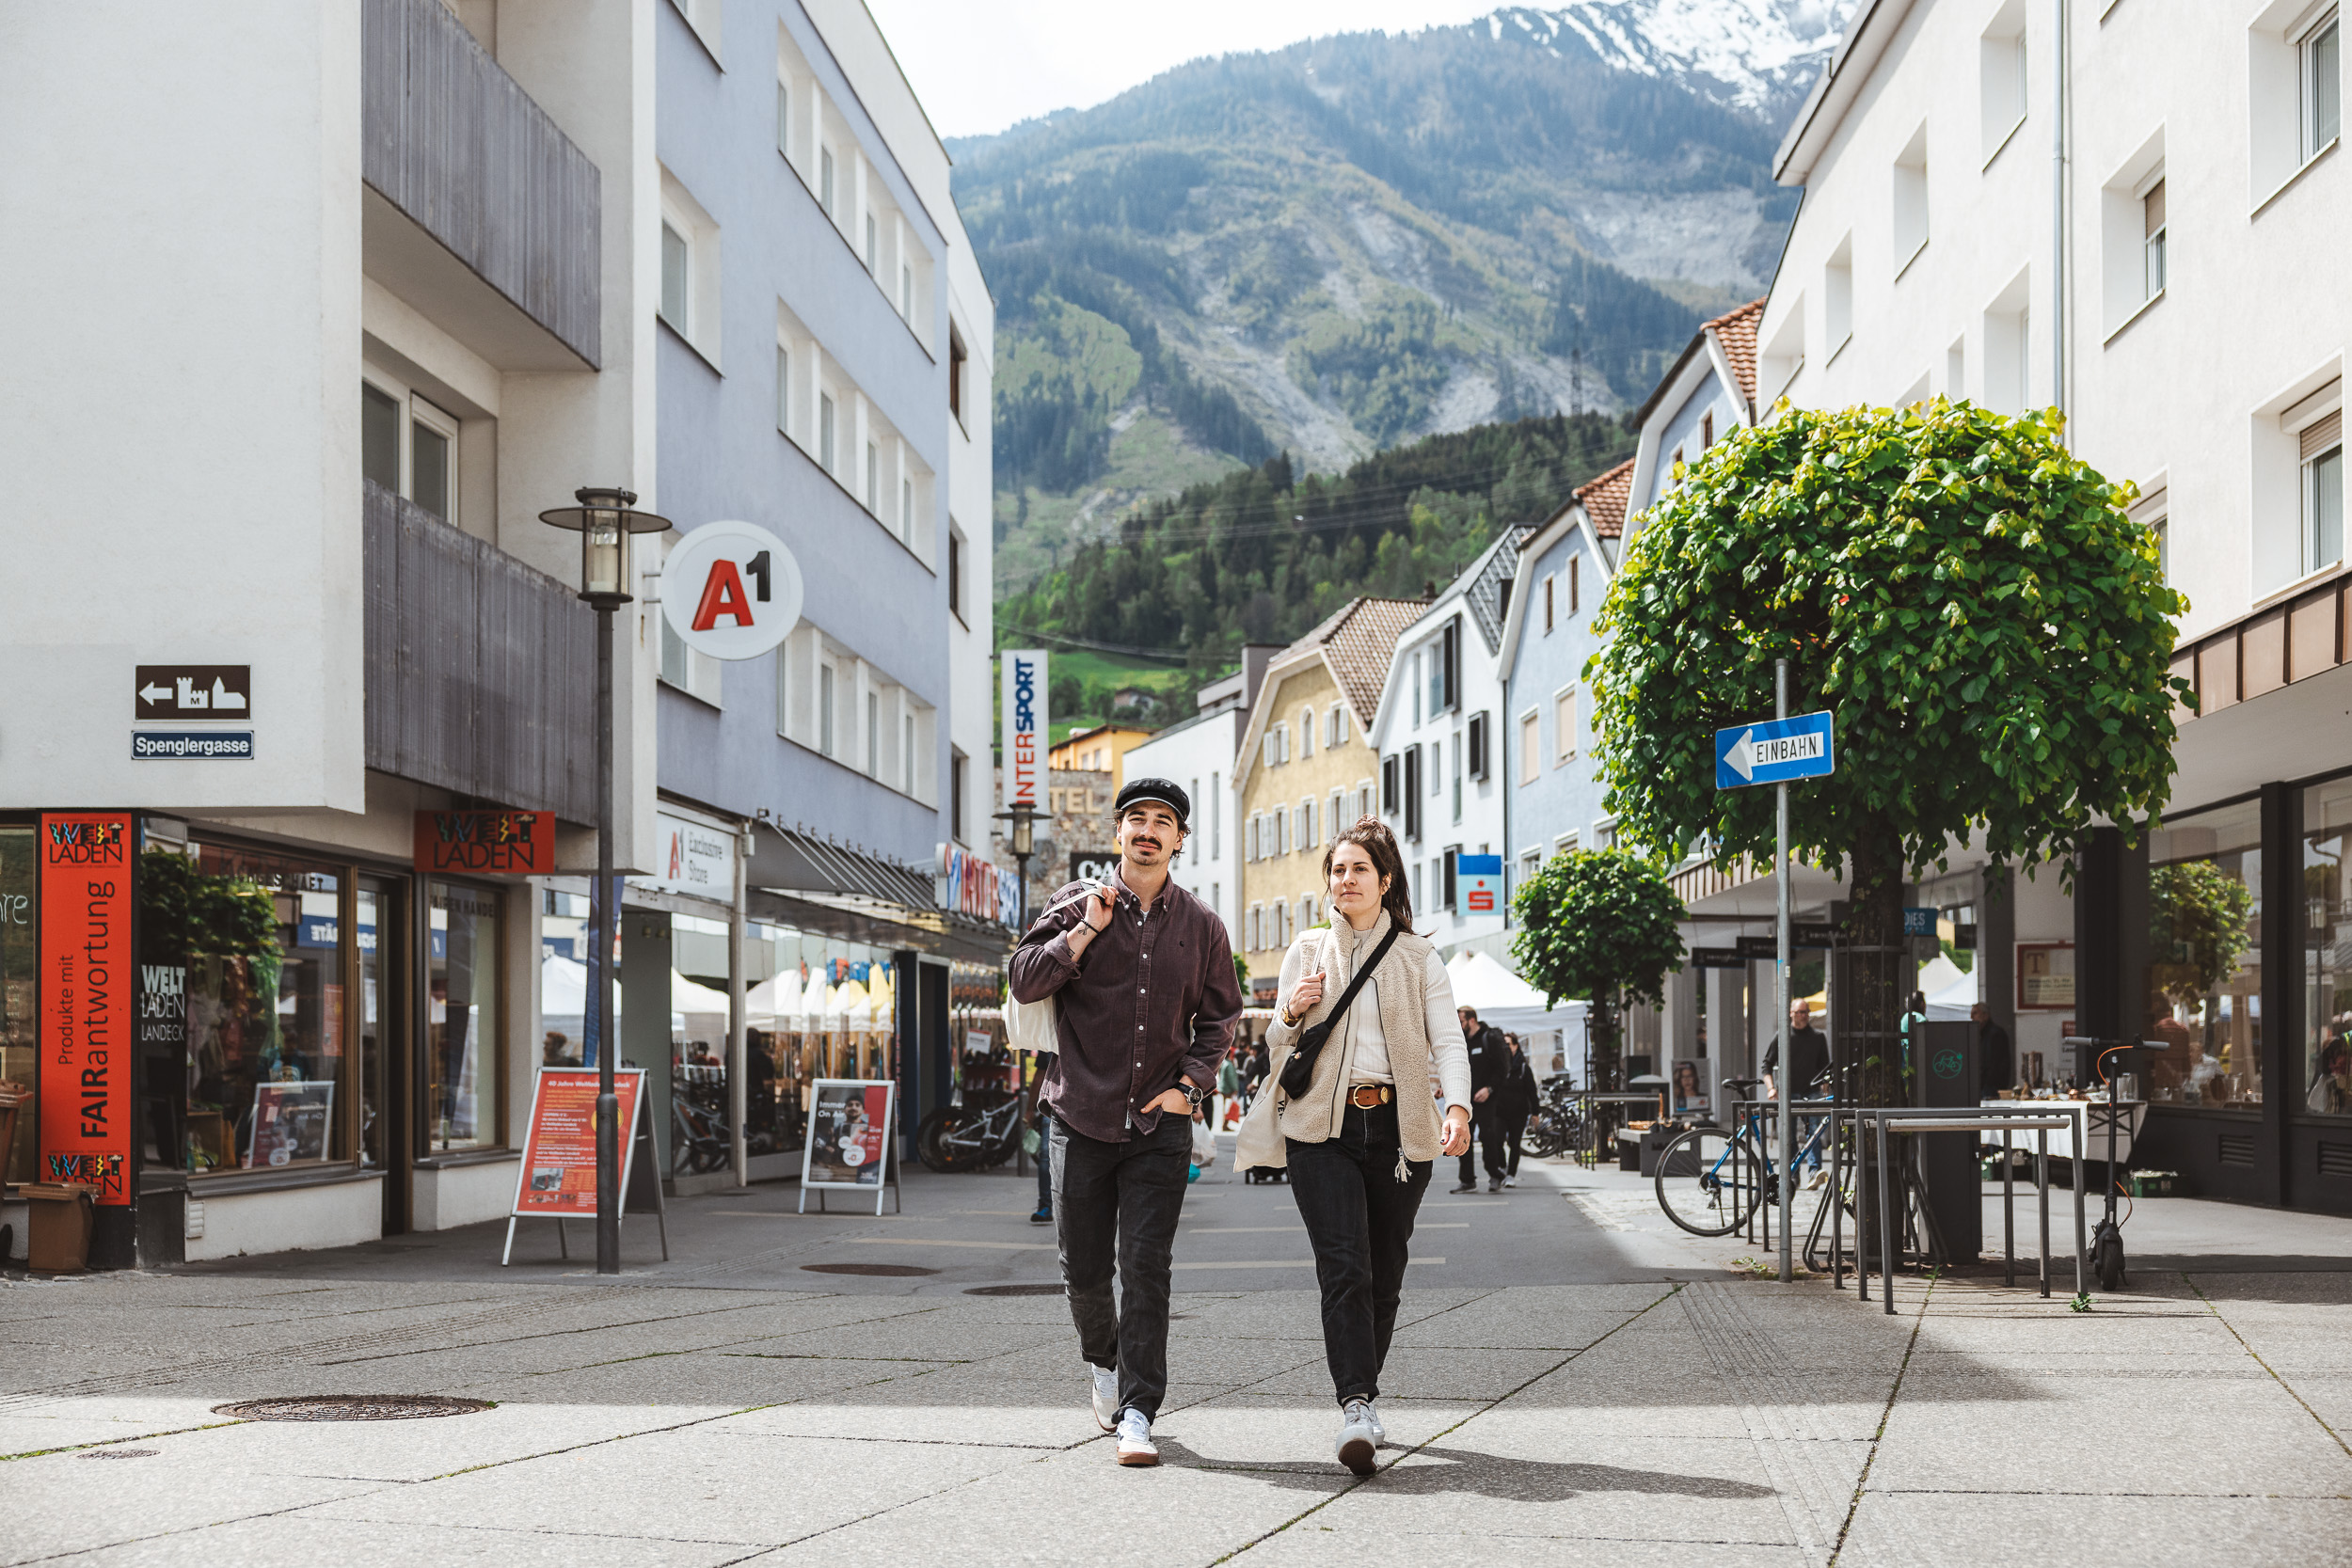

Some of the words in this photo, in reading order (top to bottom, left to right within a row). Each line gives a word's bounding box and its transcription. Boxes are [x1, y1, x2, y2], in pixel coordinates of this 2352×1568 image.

[691, 550, 771, 631] A1
[190, 697, 200, 705] M
[1015, 657, 1036, 804] INTERSPORT
[135, 736, 249, 756] Spenglergasse
[1756, 736, 1817, 764] EINBAHN
[1049, 785, 1103, 815] TEL
[48, 822, 124, 845] WELT
[434, 813, 537, 844] WELT
[49, 844, 122, 863] LADEN
[434, 842, 534, 869] LADEN
[689, 859, 708, 884] Store
[1076, 859, 1114, 881] C&A
[58, 955, 73, 982] mit
[141, 964, 185, 996] WELT
[81, 880, 115, 1138] FAIRantwortung
[141, 992, 185, 1018] LADEN
[58, 988, 73, 1065] Produkte
[141, 1024, 184, 1041] LANDECK
[818, 1101, 846, 1109] Immer
[48, 1153, 124, 1176] WELT
